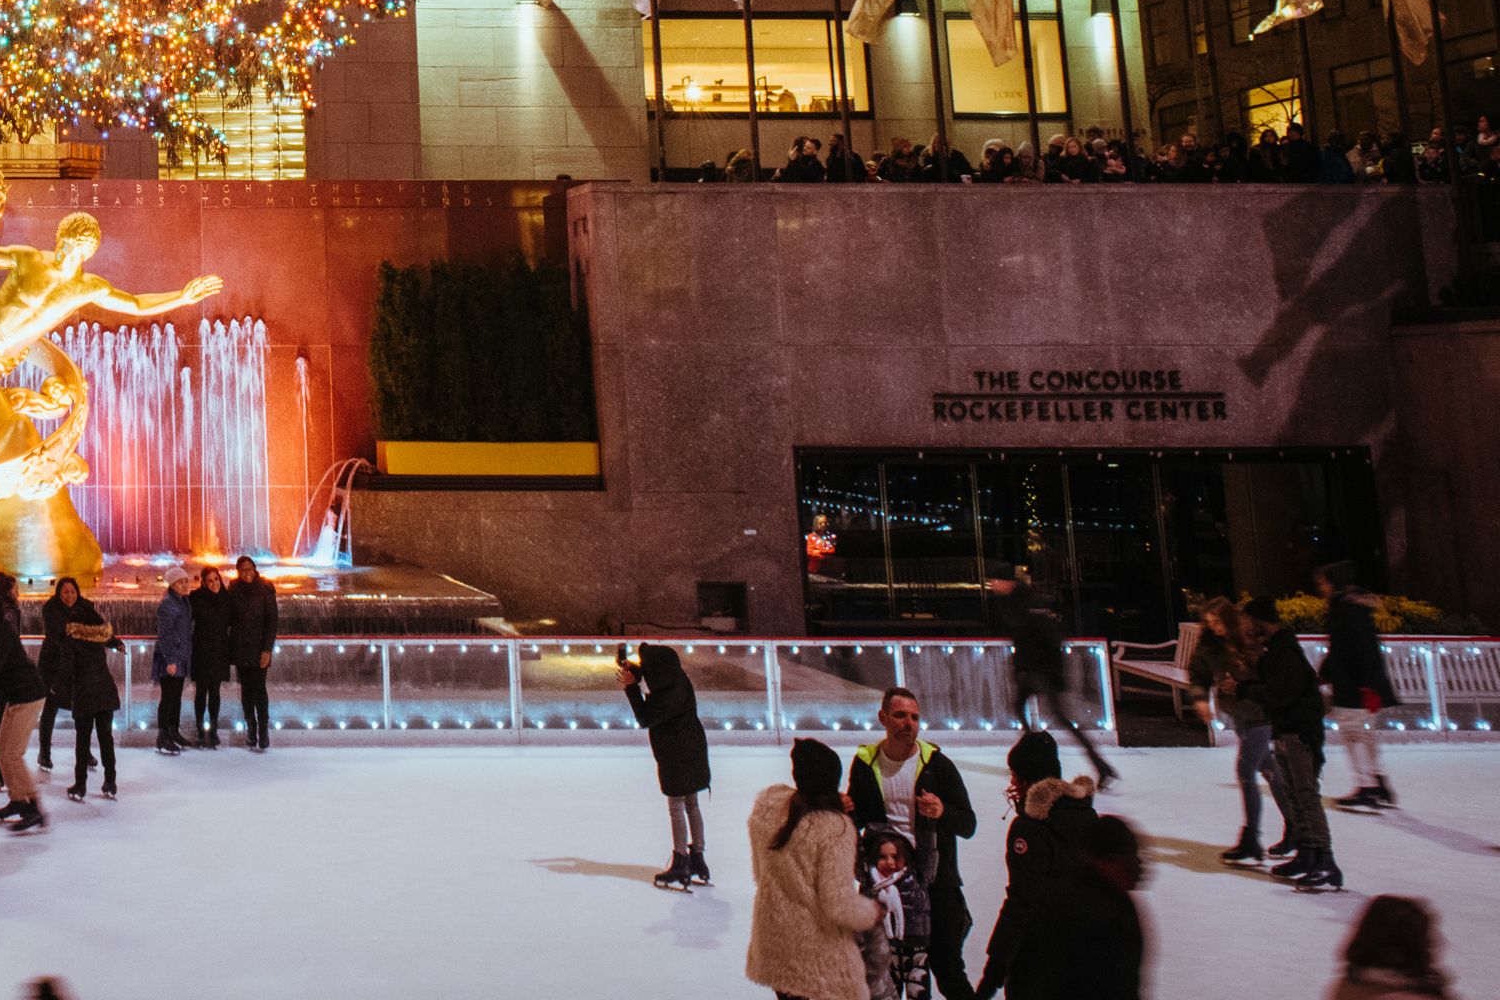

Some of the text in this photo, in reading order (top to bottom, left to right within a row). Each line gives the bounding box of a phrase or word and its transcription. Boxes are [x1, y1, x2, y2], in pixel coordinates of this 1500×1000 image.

[48, 184, 99, 193] ART
[310, 184, 361, 193] THE
[398, 184, 470, 193] FIRE
[70, 197, 164, 206] MEANS
[202, 197, 231, 206] TO
[266, 197, 383, 206] MIGHTY
[421, 197, 493, 206] ENDS
[973, 369, 1182, 391] THE CONCOURSE
[932, 401, 1228, 422] ROCKEFELLER CENTER
